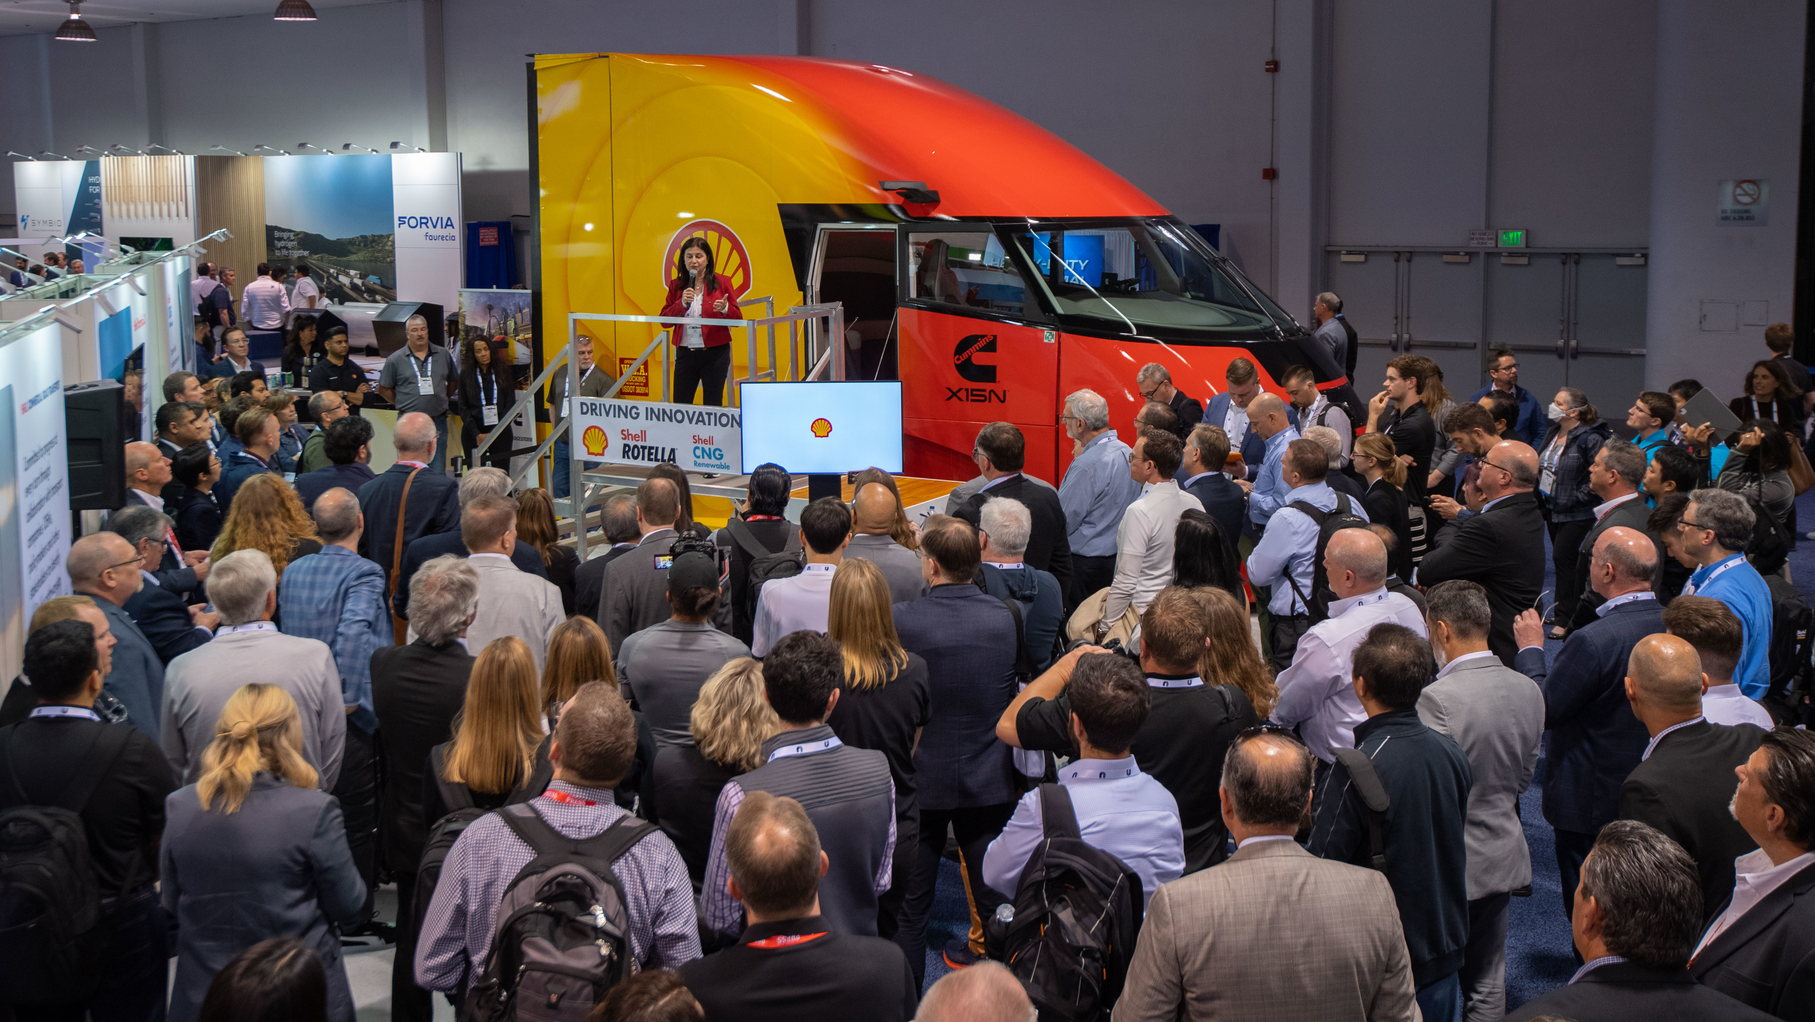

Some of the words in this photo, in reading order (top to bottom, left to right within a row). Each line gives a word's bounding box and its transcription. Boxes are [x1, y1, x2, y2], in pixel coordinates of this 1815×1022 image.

[31, 219, 62, 227] SYMBIO
[398, 216, 455, 229] FORVIA
[274, 231, 295, 239] Bringing
[425, 232, 456, 241] faurecia
[1502, 231, 1523, 246] EXIT
[954, 334, 994, 365] Cummins
[945, 386, 1007, 404] X15N
[580, 401, 640, 420] DRIVING
[645, 407, 741, 428] INNOVATION
[620, 428, 647, 443] Shell
[692, 434, 714, 446] Shell
[622, 443, 676, 464] ROTELLA
[693, 446, 724, 461] CNG
[694, 460, 731, 471] Renewable
